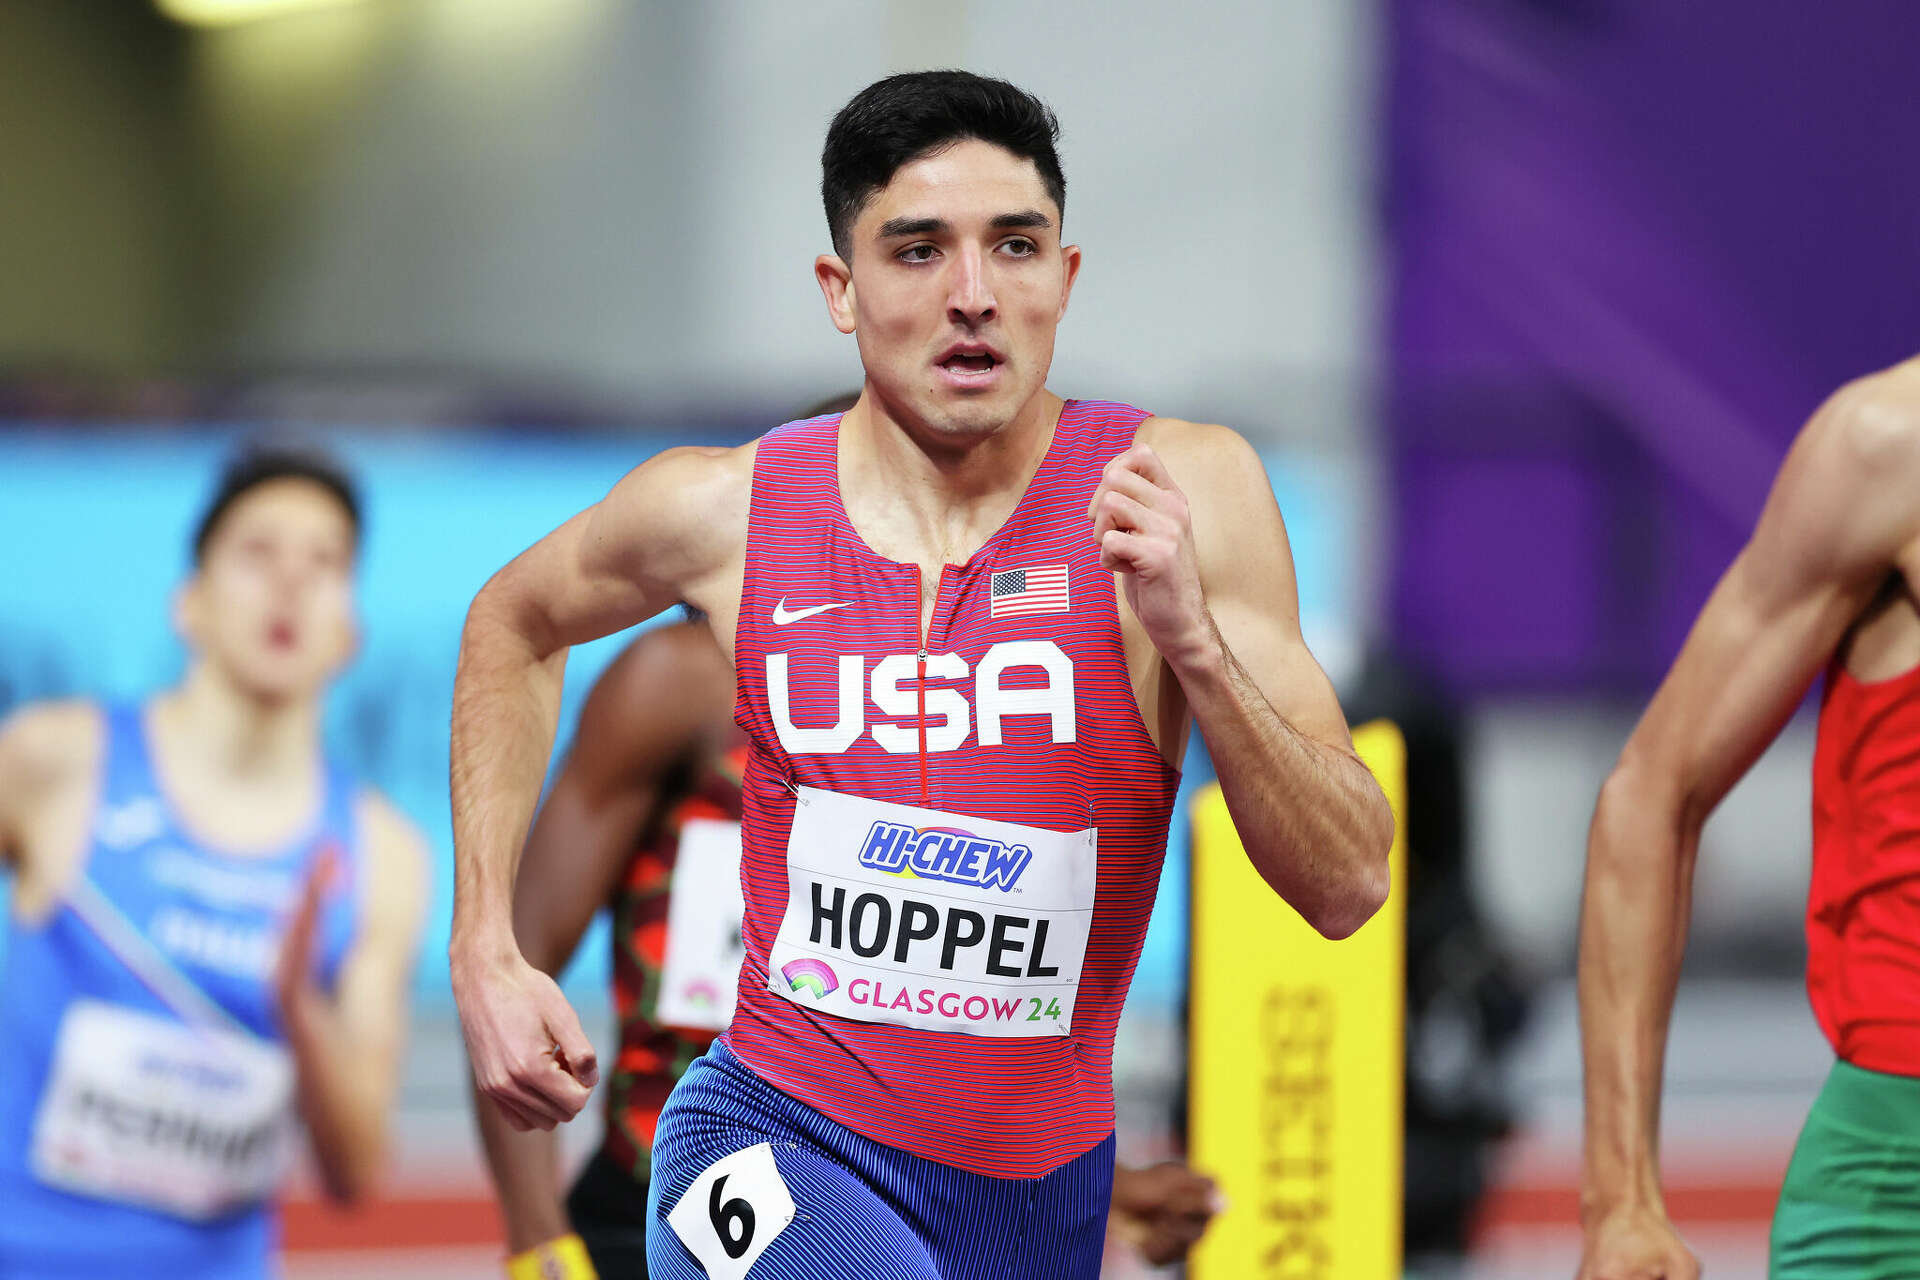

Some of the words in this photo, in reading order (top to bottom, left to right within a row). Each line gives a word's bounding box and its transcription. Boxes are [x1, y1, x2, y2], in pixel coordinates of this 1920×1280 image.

[766, 640, 1077, 754] USA
[858, 820, 1033, 893] HI-CHEW
[809, 882, 1060, 978] HOPPEL
[848, 978, 1023, 1022] GLASGOW
[1025, 996, 1062, 1022] 24
[1260, 985, 1336, 1280] SEIK
[708, 1173, 756, 1260] 6
